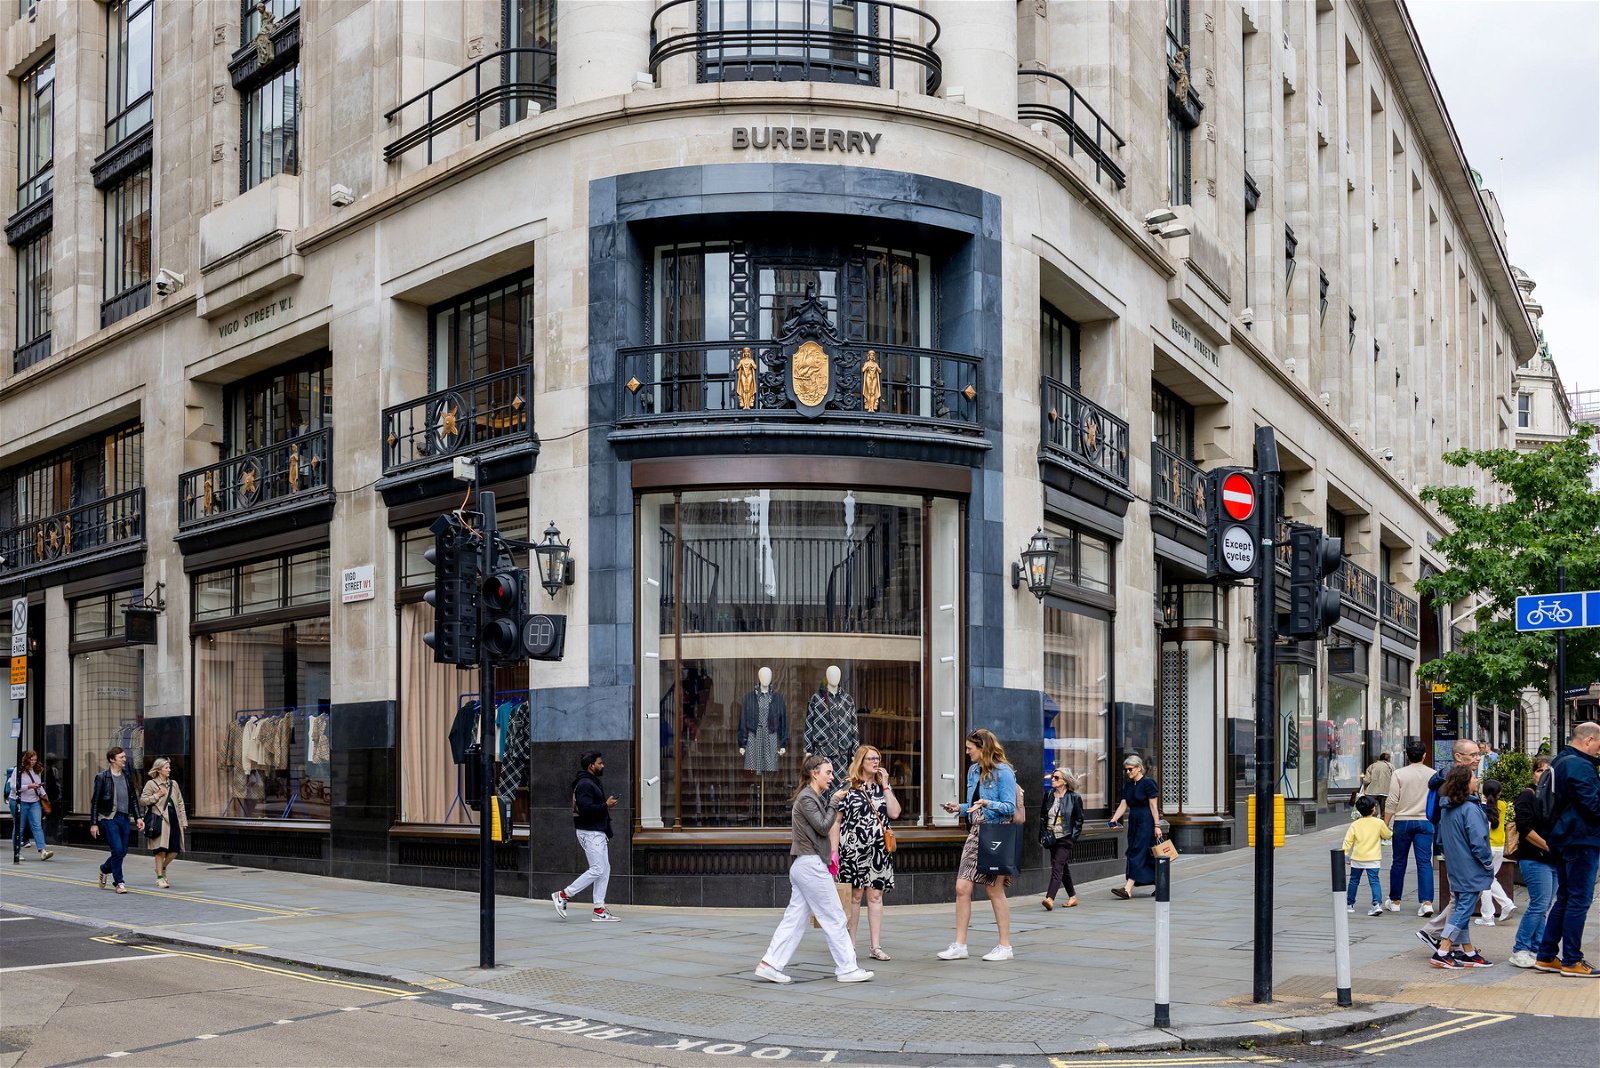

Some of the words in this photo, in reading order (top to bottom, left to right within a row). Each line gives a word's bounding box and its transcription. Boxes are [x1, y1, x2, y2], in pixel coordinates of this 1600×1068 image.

[732, 126, 882, 154] BURBERRY
[218, 319, 240, 338] VIGO
[243, 302, 277, 328] STREET
[1171, 317, 1191, 344] REGENT
[1193, 336, 1211, 361] STREET
[1225, 538, 1252, 551] Except
[1226, 551, 1251, 562] cycles
[344, 571, 357, 581] VIGO
[344, 580, 362, 592] STREET
[362, 579, 372, 589] W1
[13, 643, 26, 654] ENDS
[473, 1009, 652, 1040] RIGHT
[655, 1038, 839, 1063] LOOK
